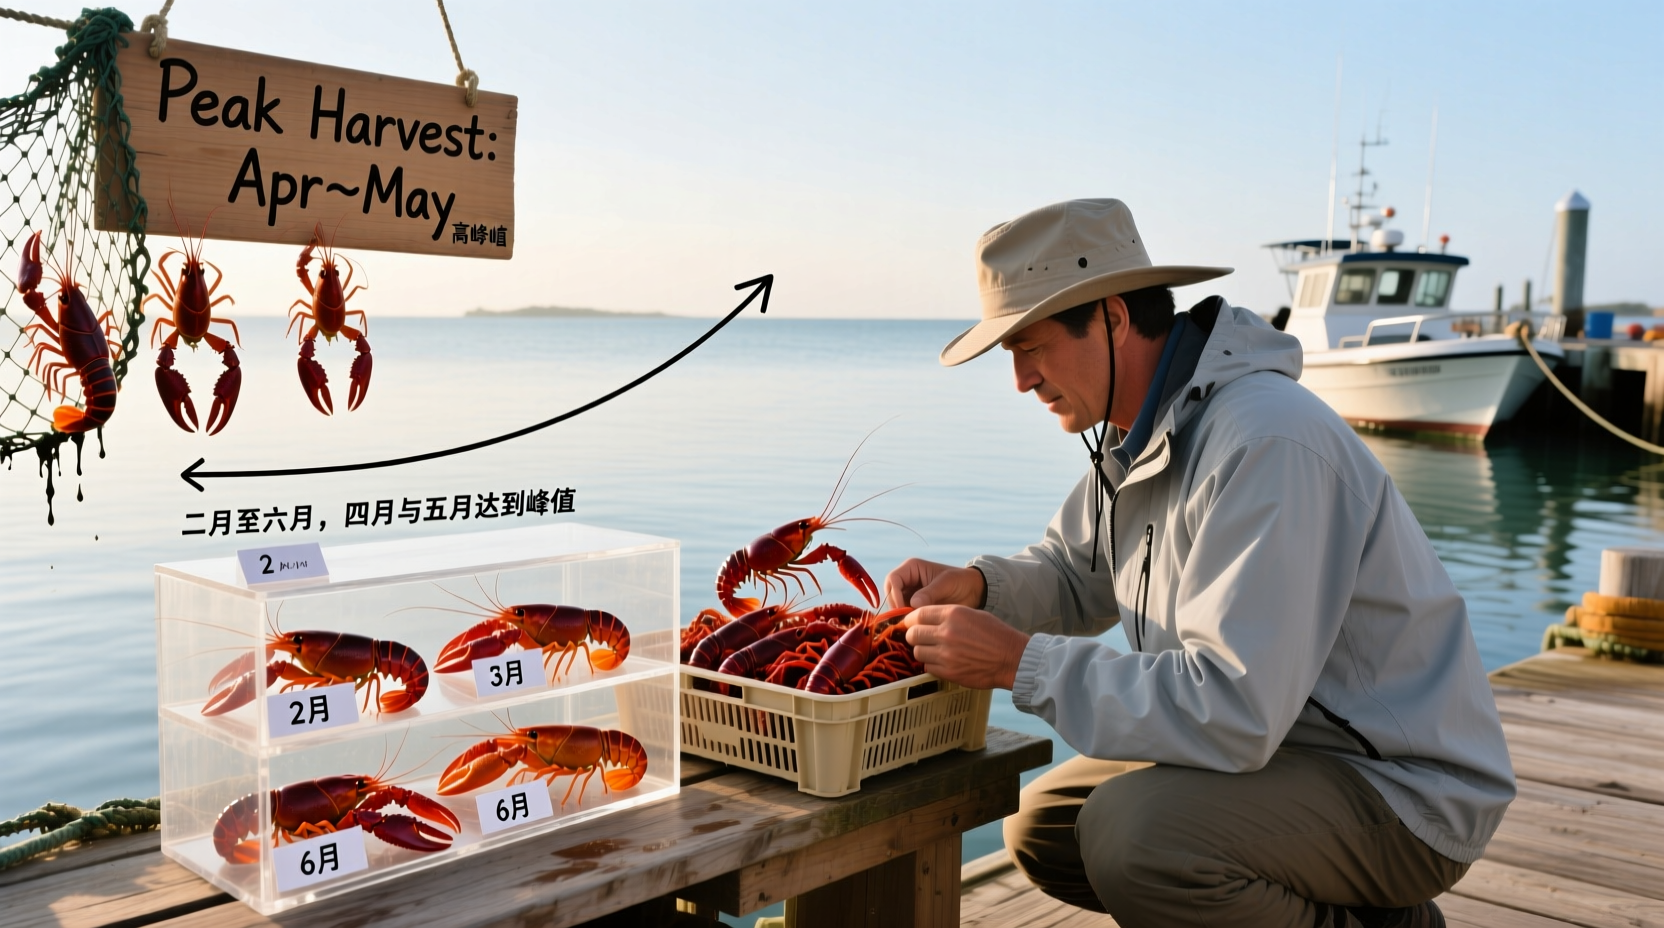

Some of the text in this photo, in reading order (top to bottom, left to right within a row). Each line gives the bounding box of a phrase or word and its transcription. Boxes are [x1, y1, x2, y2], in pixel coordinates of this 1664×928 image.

[158, 57, 498, 161] Peak Harvest:
[227, 147, 456, 241] Apr~May
[259, 554, 275, 575] 2
[489, 659, 524, 687] 3月
[289, 694, 330, 726] 2月
[496, 791, 530, 822] 6月
[300, 842, 340, 876] 6月
